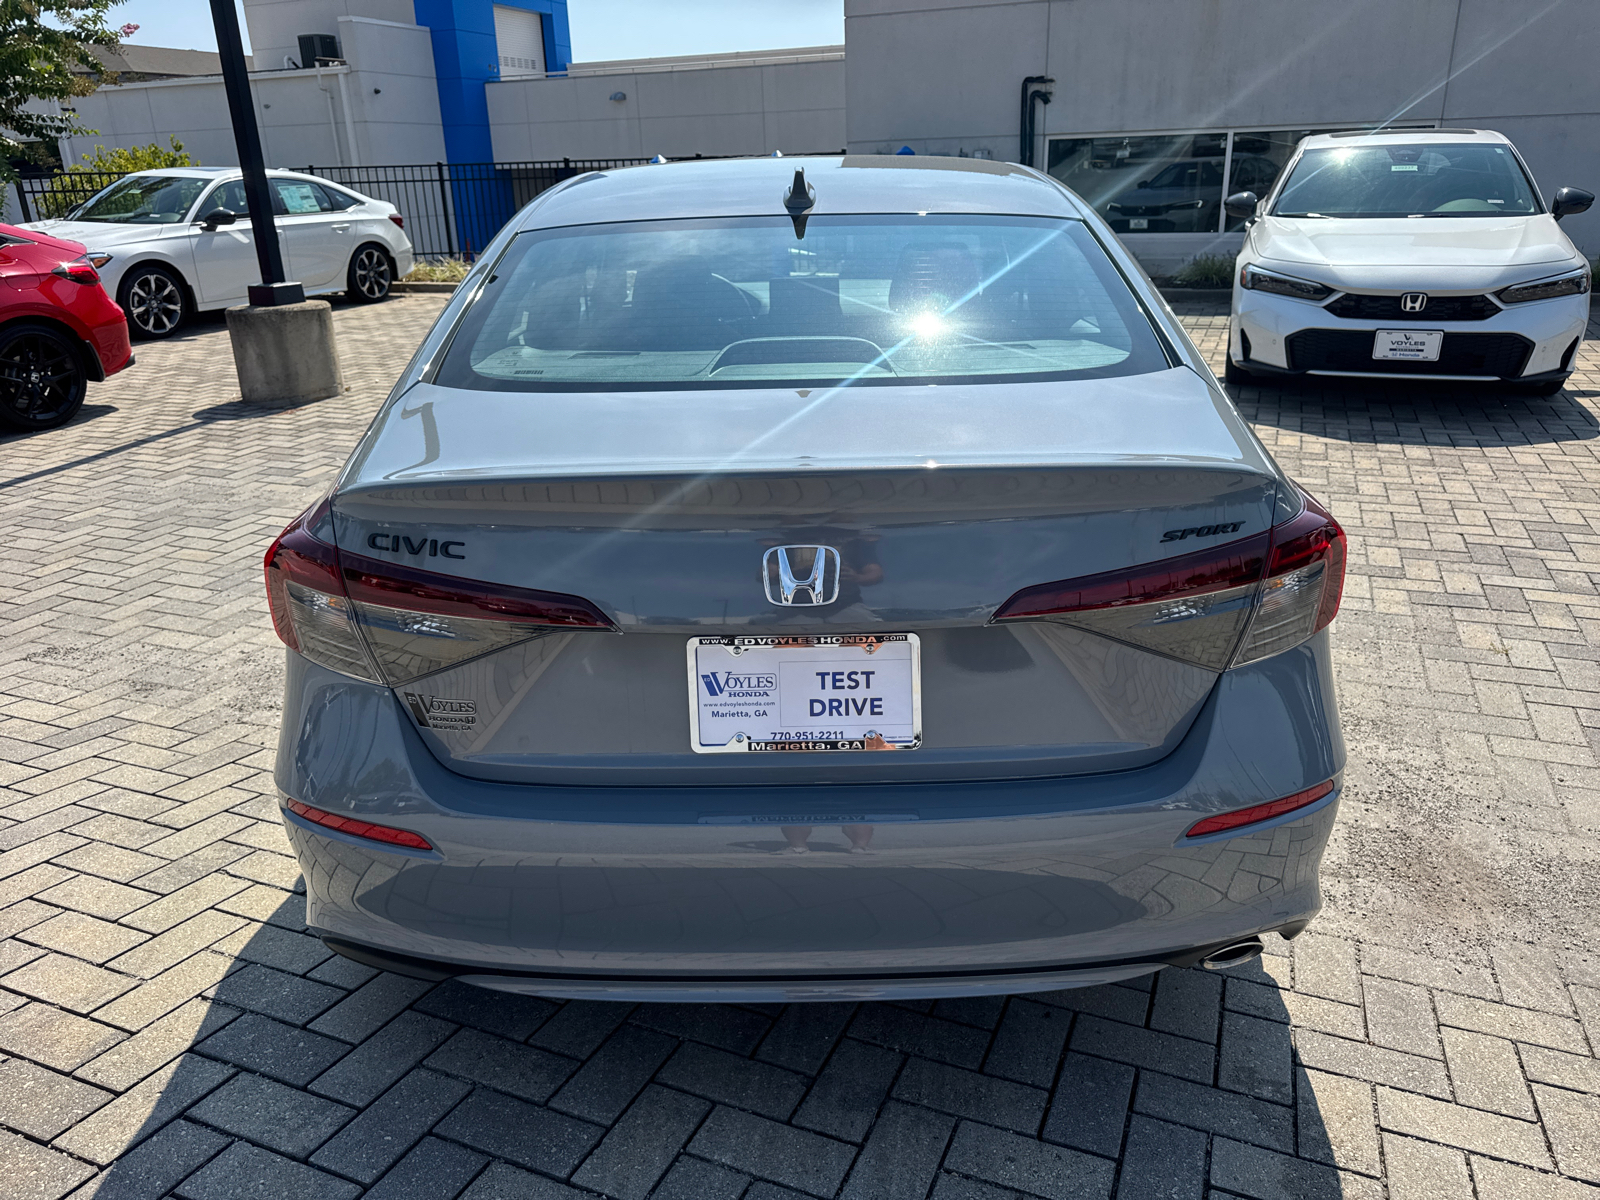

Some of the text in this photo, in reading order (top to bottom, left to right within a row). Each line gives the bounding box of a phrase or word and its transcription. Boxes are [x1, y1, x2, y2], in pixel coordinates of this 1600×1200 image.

[1159, 520, 1246, 543] SPORT
[367, 532, 466, 560] CIVIC
[710, 671, 774, 695] VOYLES
[815, 671, 875, 690] TEST
[417, 693, 475, 714] VOYLES
[809, 697, 884, 717] DRIVE
[428, 715, 465, 723] HONDA
[711, 709, 768, 718] Marietta, GA
[770, 730, 844, 740] 770-951-2211
[750, 740, 863, 750] Marietta, GA
